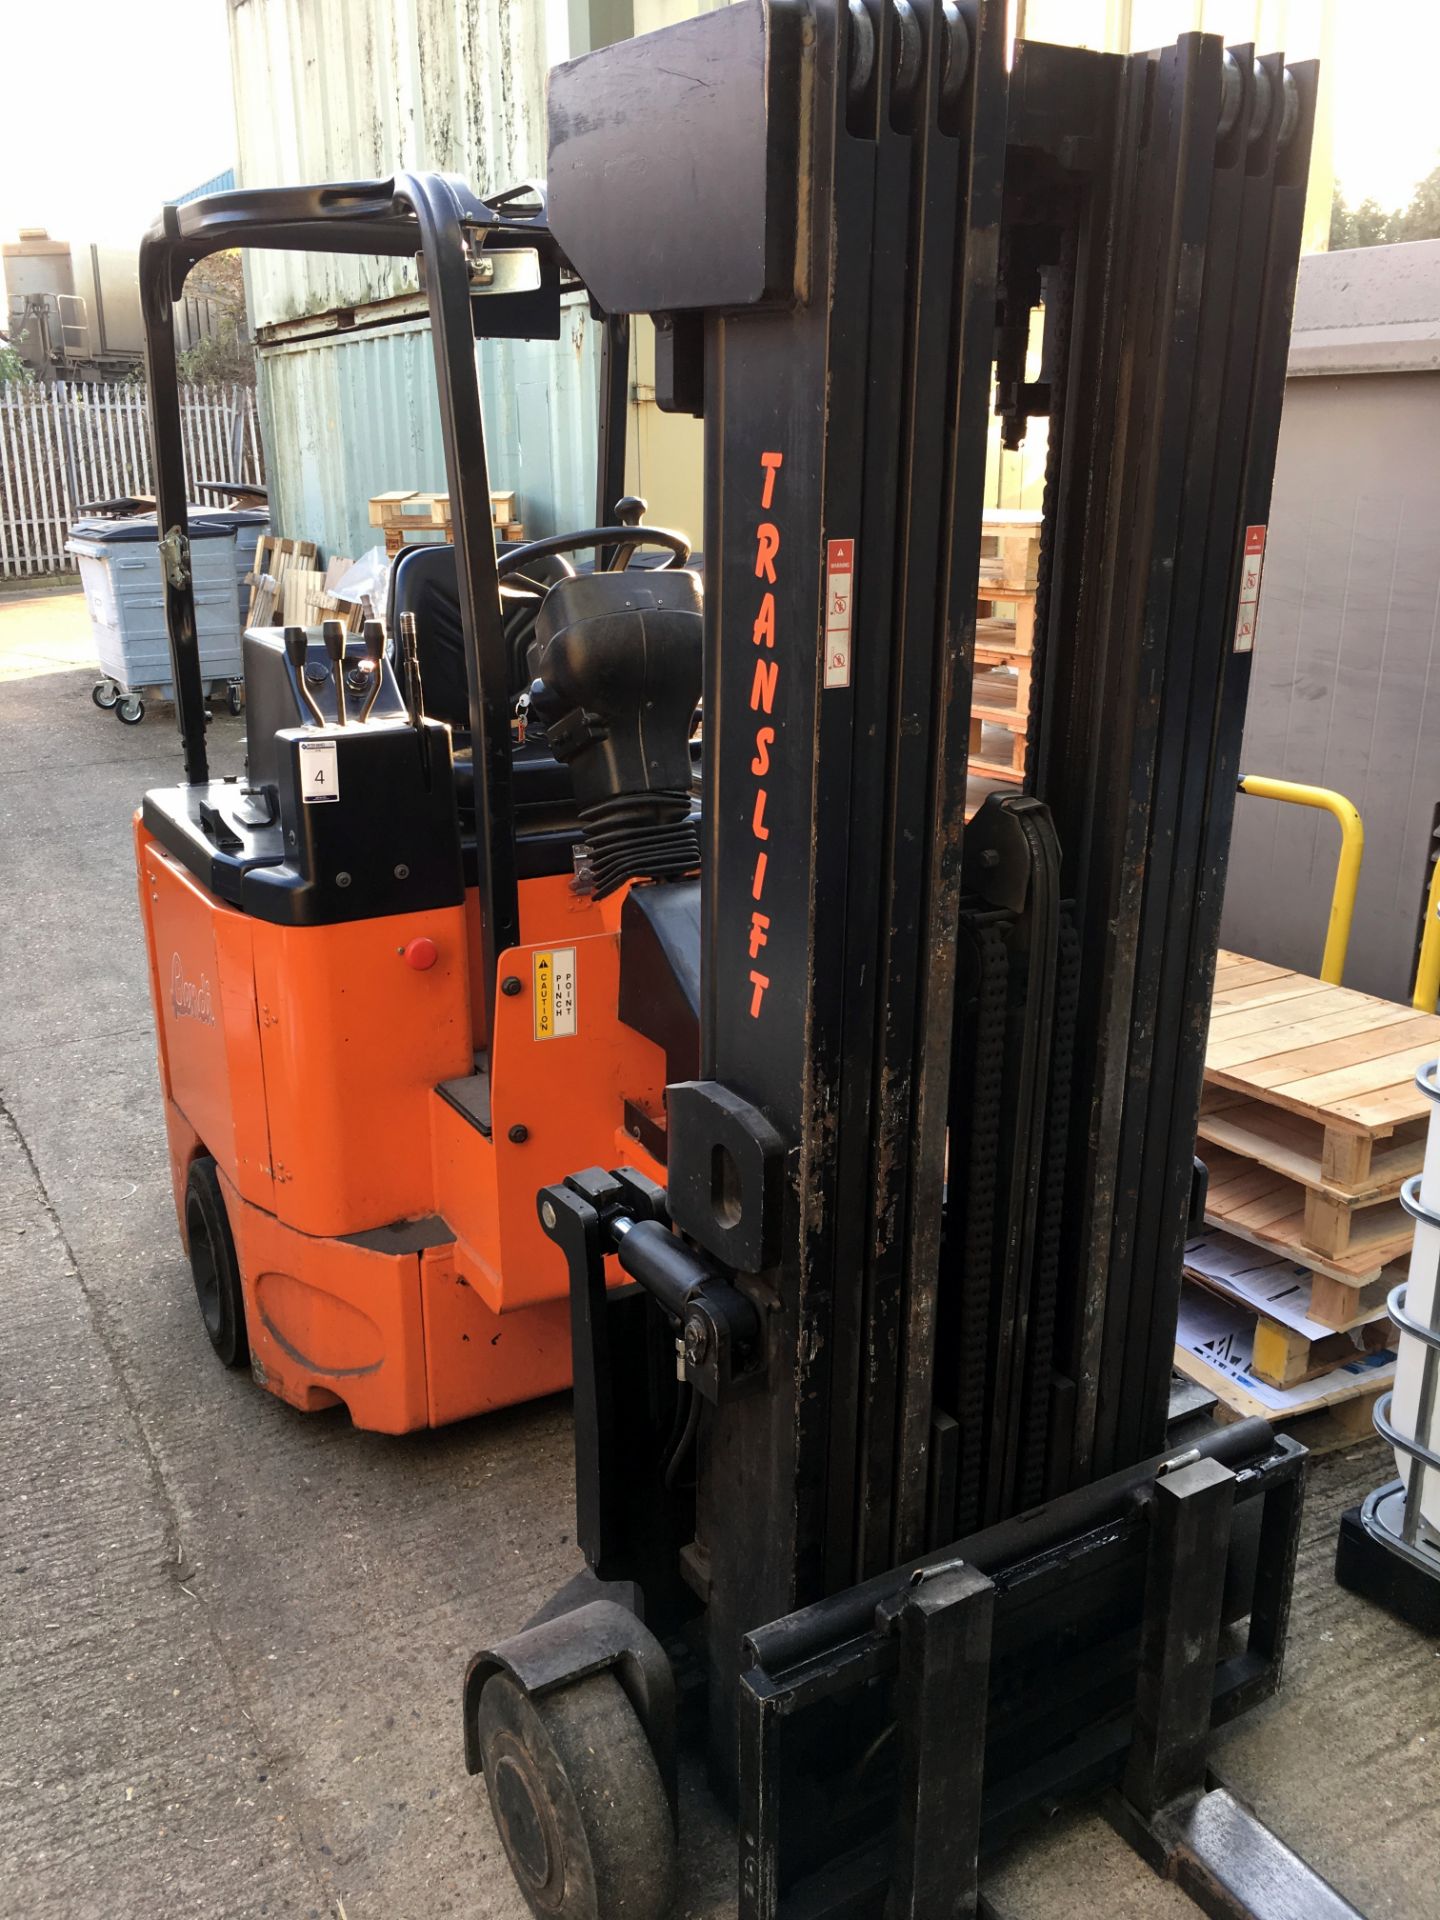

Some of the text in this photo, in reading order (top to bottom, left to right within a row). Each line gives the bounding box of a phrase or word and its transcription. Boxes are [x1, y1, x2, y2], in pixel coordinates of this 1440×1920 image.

[750, 451, 784, 1019] TRANSLIFT
[314, 769, 325, 785] 4
[540, 973, 548, 1031] CAUTION
